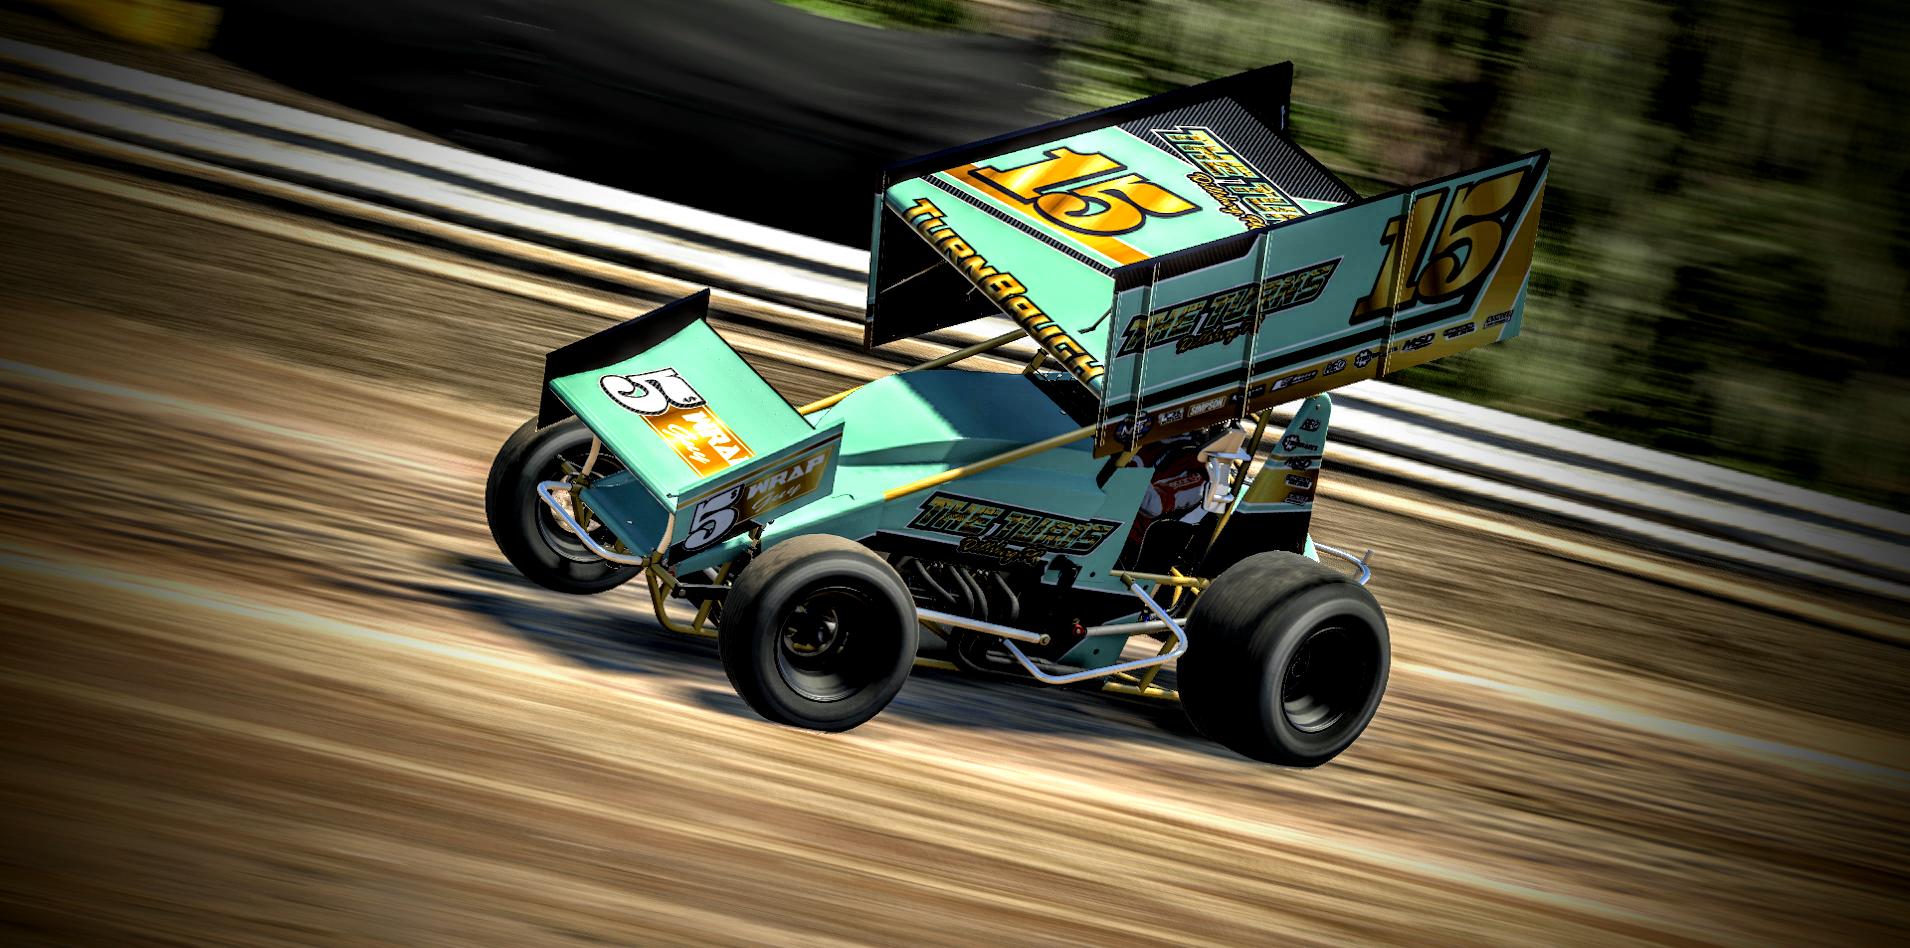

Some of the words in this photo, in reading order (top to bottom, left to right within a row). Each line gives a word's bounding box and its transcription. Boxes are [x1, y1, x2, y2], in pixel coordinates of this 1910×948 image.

[1164, 130, 1261, 178] THE
[968, 146, 1203, 237] 15
[1349, 165, 1533, 325] 15
[682, 410, 751, 463] WRA
[748, 454, 826, 501] WRAP
[915, 495, 1005, 535] THE
